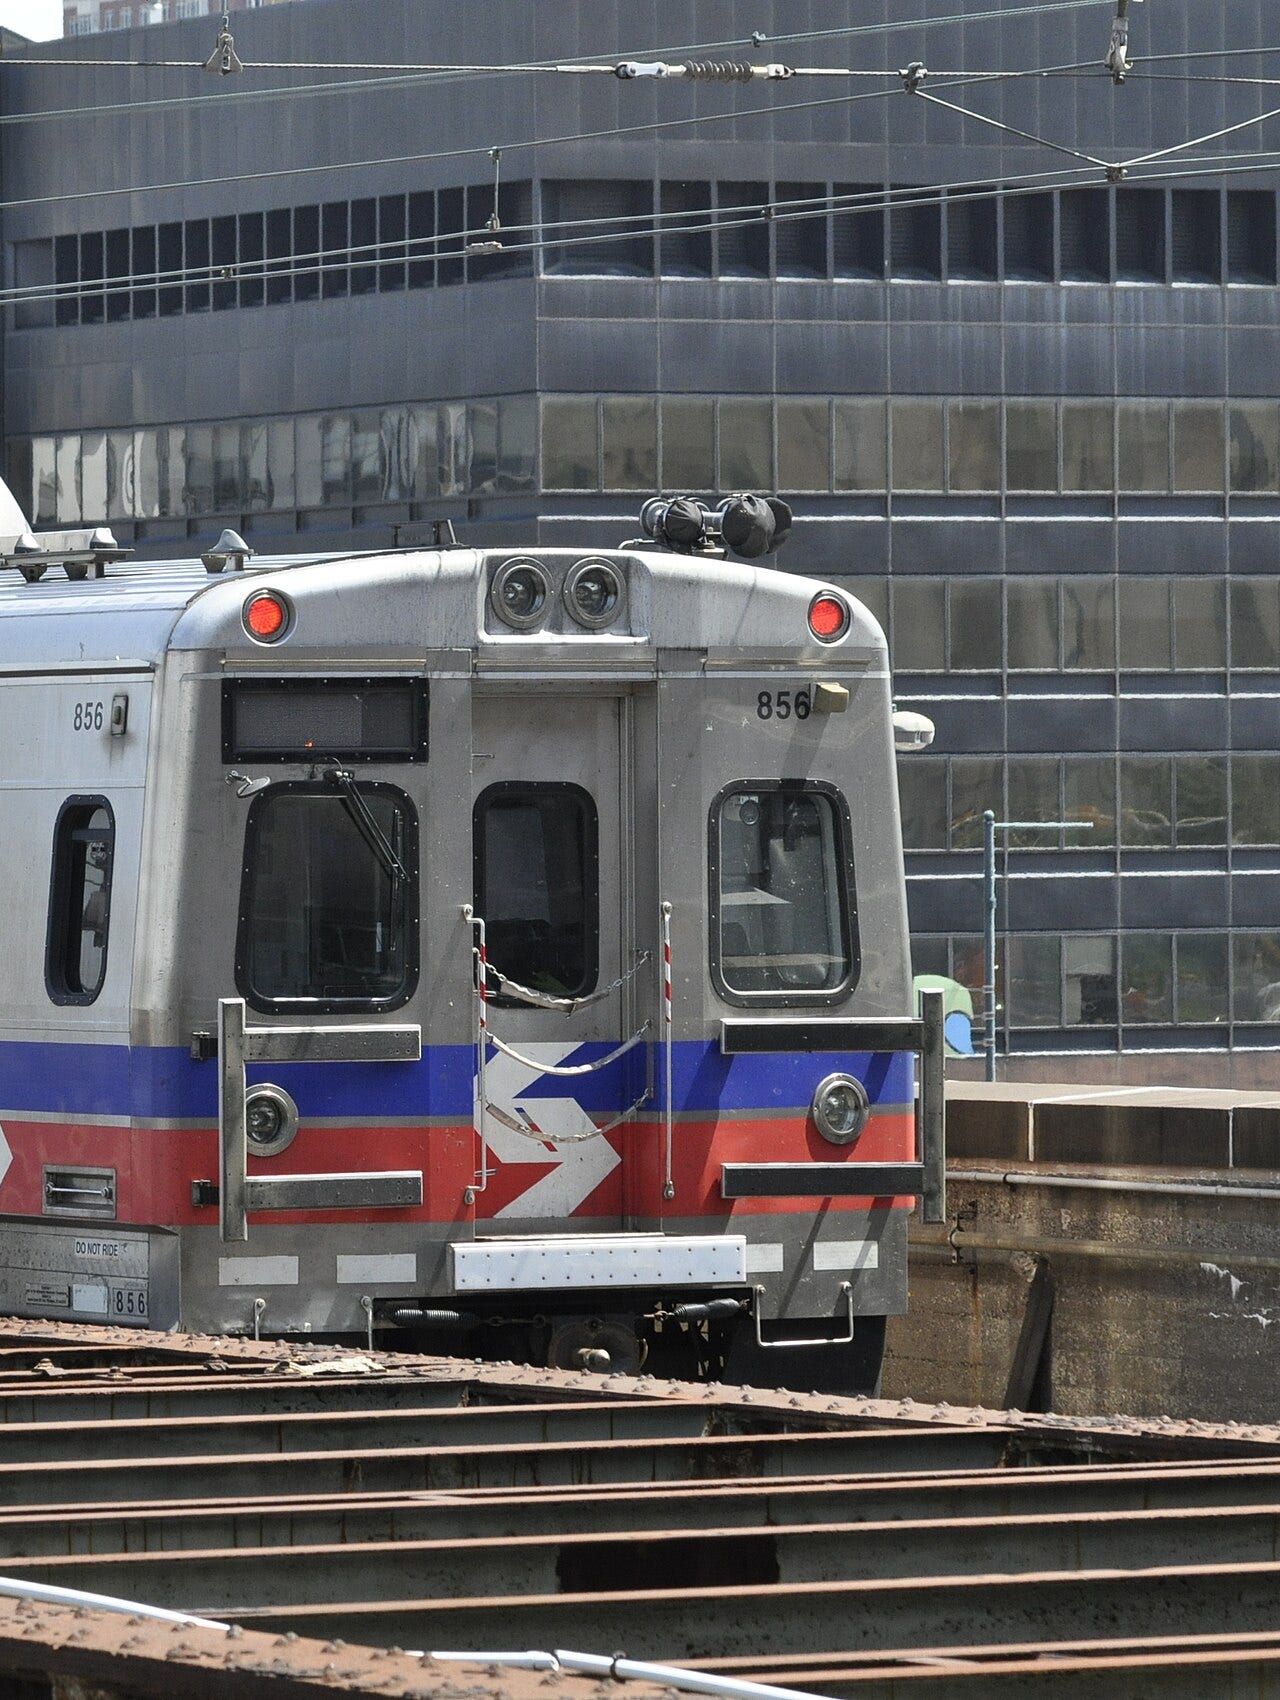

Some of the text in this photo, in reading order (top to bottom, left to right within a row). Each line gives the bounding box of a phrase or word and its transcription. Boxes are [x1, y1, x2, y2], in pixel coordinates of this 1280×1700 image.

[73, 701, 104, 731] 856
[757, 690, 811, 720] 856
[76, 1241, 118, 1257] DO NOT RIDE
[116, 1290, 145, 1314] 856
